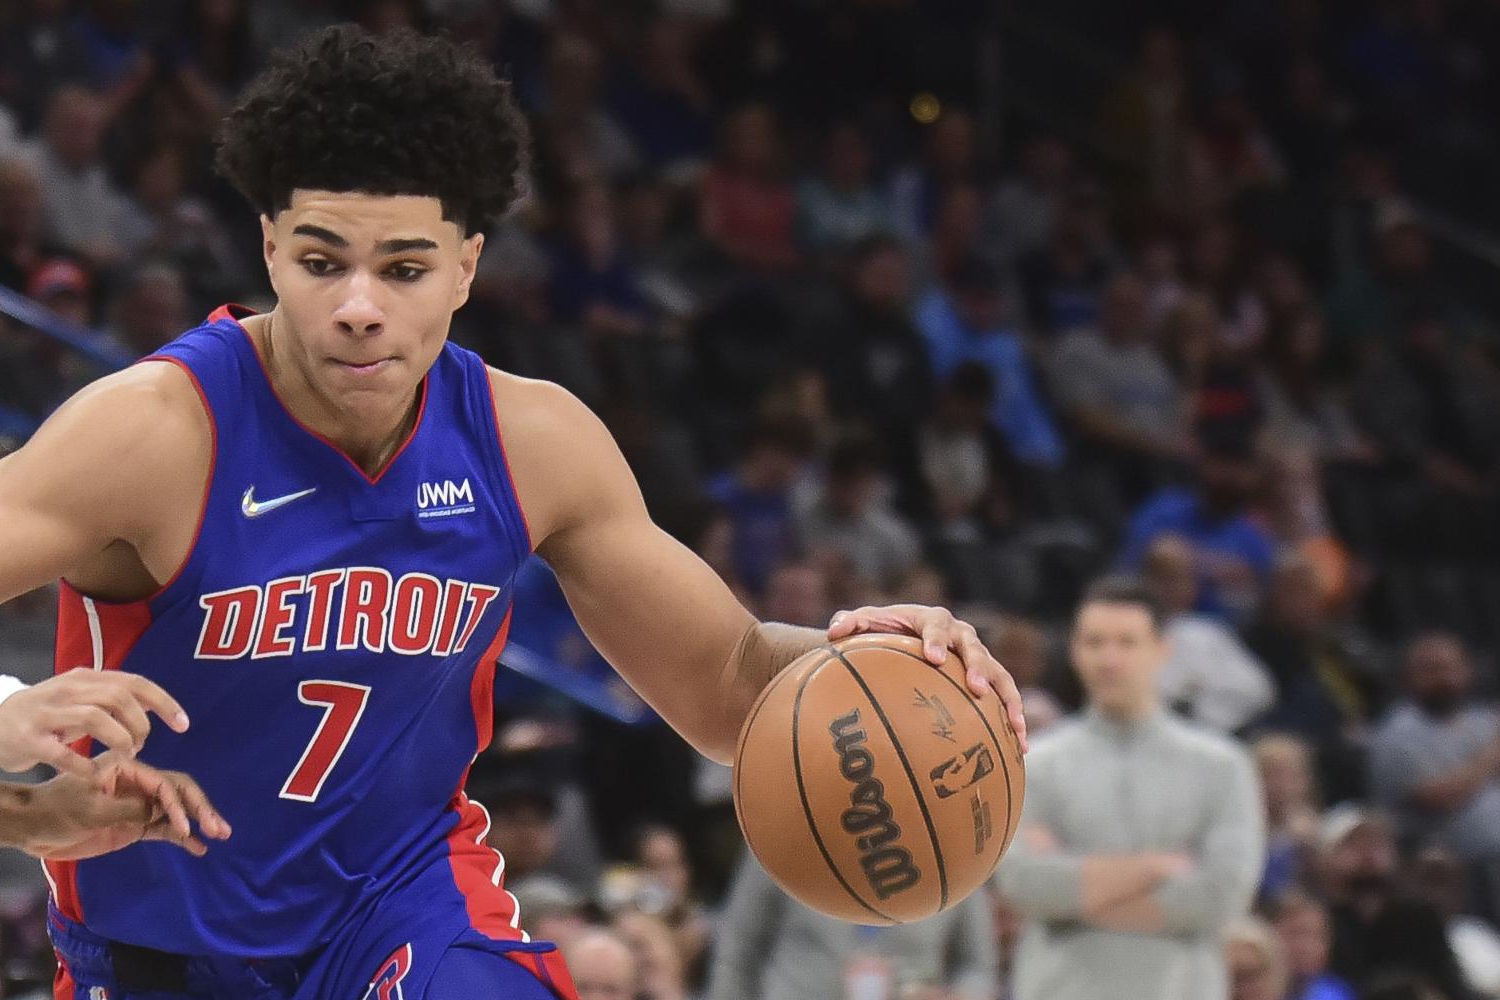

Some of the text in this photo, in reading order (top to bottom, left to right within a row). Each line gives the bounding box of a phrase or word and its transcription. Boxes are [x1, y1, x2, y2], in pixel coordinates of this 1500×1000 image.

[417, 478, 474, 509] UWM
[194, 566, 500, 660] DETROIT
[279, 680, 372, 802] 7
[828, 707, 922, 901] Wilson
